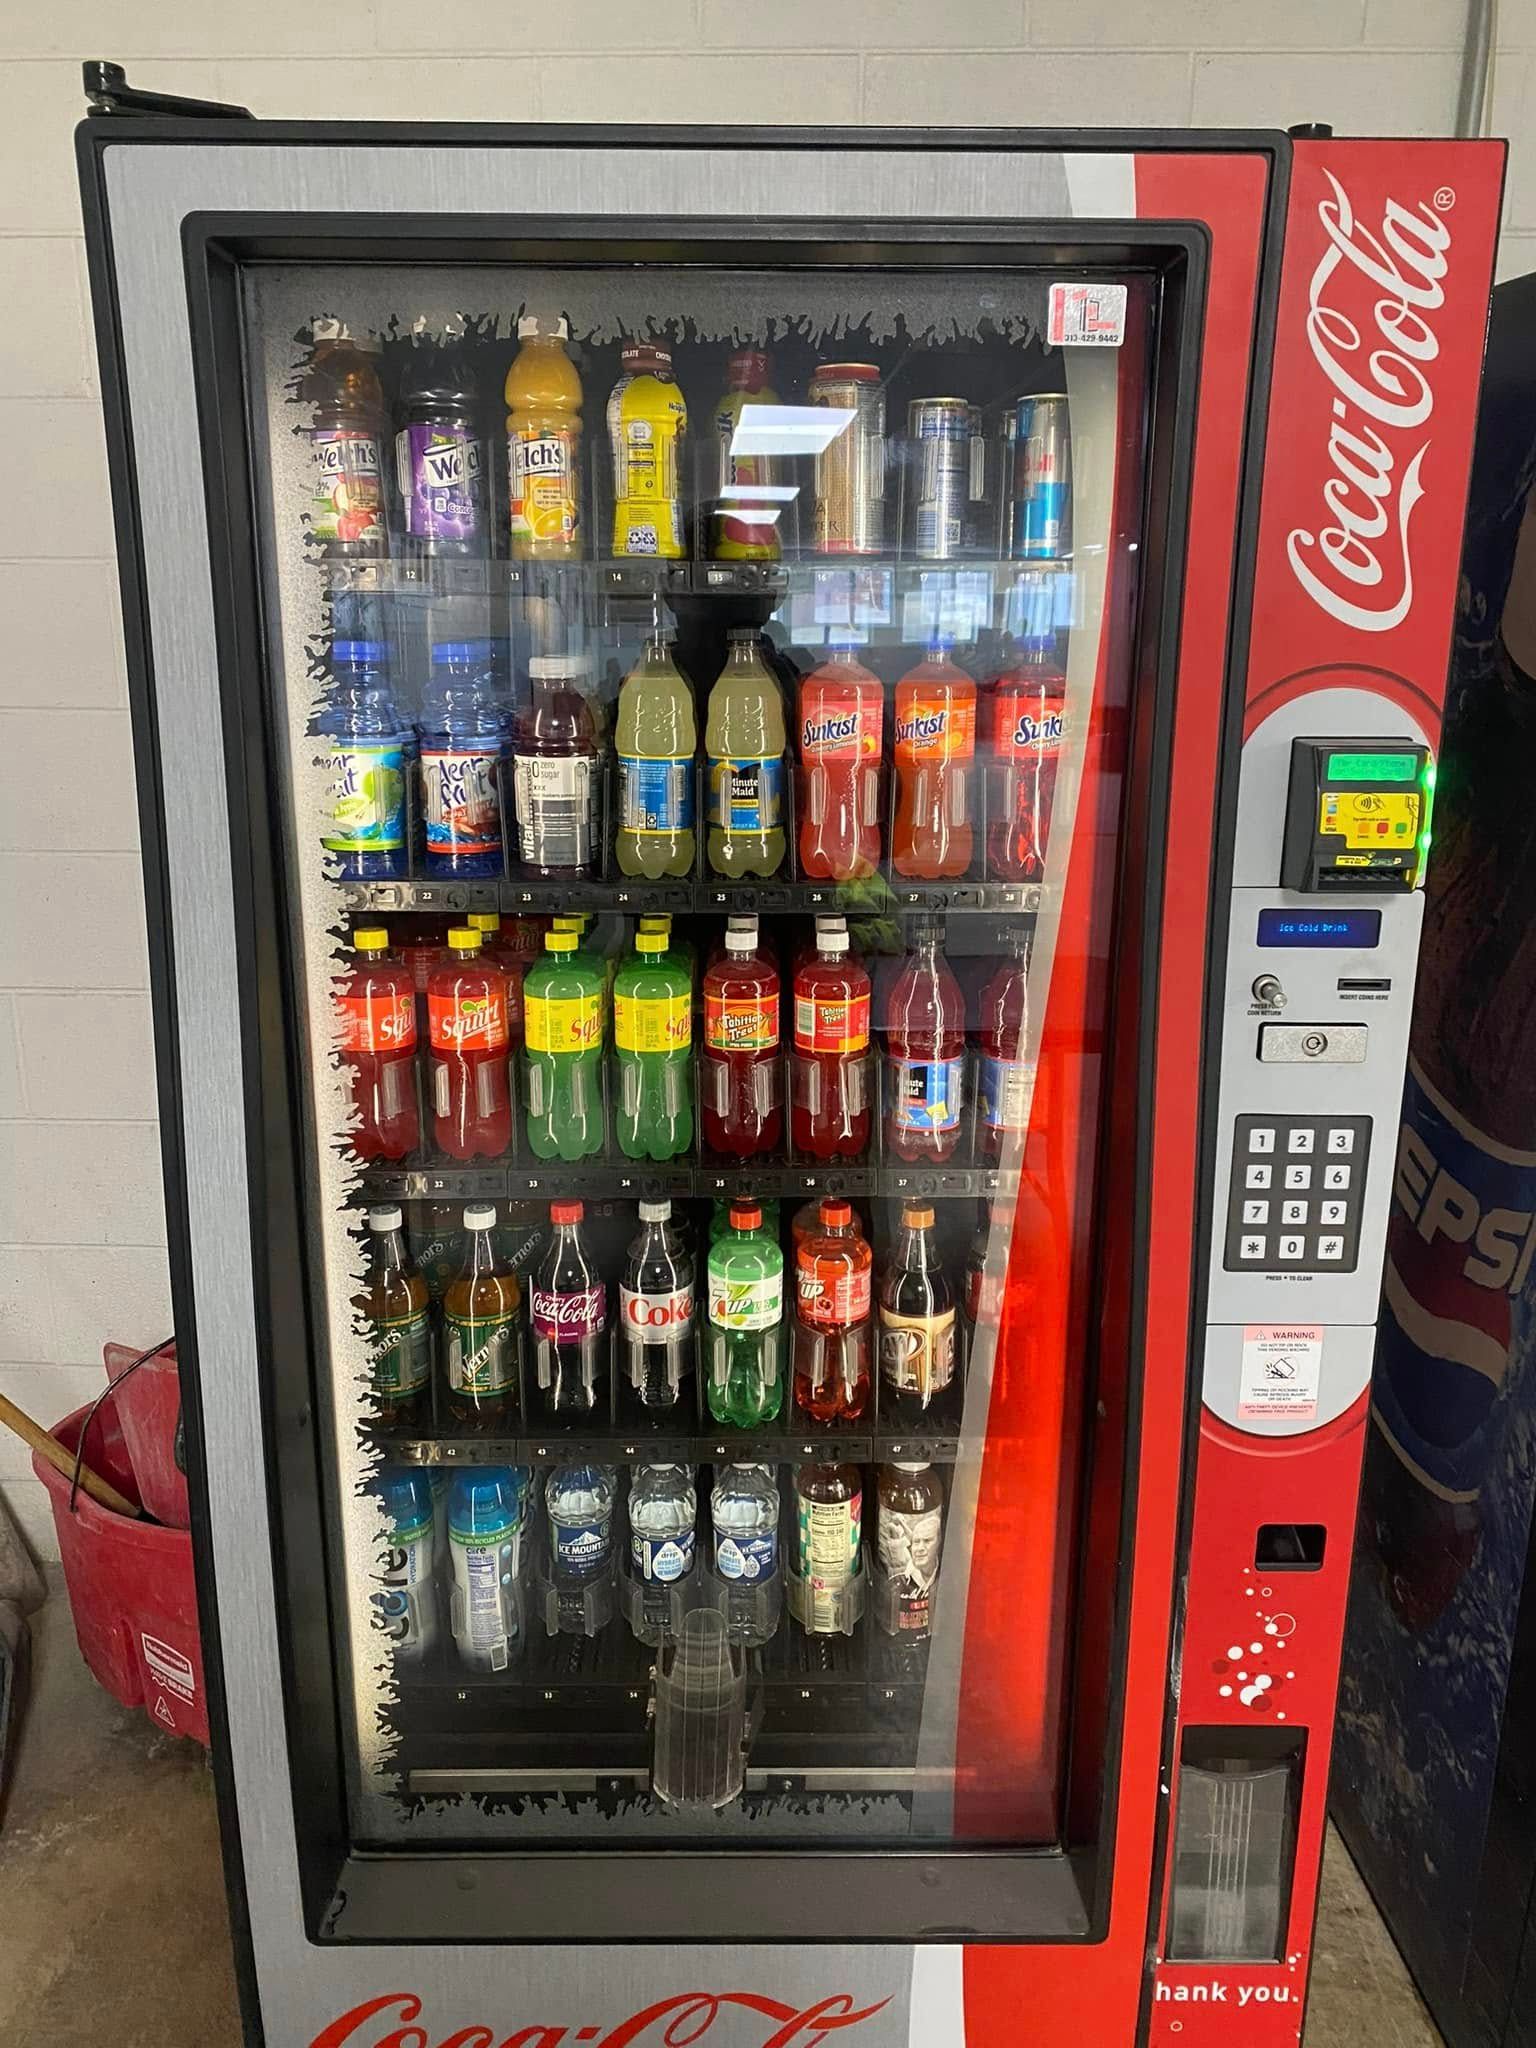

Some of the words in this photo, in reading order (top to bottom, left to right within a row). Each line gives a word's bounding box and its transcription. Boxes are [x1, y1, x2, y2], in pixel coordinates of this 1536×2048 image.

[1288, 168, 1451, 632] Coca-Cola
[406, 570, 416, 579] 12
[510, 572, 520, 580] 13
[612, 573, 622, 581] 14
[804, 713, 858, 747] Sunkist
[895, 711, 948, 744] Sunkist
[422, 892, 432, 900] 22
[522, 893, 532, 901] 23
[616, 893, 627, 901] 24
[909, 893, 919, 901] 27
[1280, 923, 1294, 932] Ice
[1298, 923, 1319, 932] Cold
[441, 1000, 499, 1043] Squirt
[722, 1013, 763, 1029] Tahitian
[729, 1023, 758, 1041] Treat
[1258, 1135, 1266, 1147] 1
[1297, 1135, 1307, 1148] 2
[1336, 1135, 1346, 1148] 3
[622, 1179, 631, 1187] 34
[898, 1178, 908, 1187] 37
[1254, 1171, 1265, 1183] 4
[1293, 1171, 1304, 1183] 5
[1333, 1171, 1343, 1184] 6
[434, 1180, 444, 1188] 32
[529, 1180, 538, 1188] 33
[1251, 1206, 1263, 1218] 7
[1290, 1206, 1301, 1218] 8
[1329, 1206, 1340, 1219] 9
[1287, 1241, 1297, 1254] 0
[1324, 1241, 1337, 1254] #
[533, 1290, 601, 1323] Coca-Cola
[628, 1295, 693, 1326] Coke
[1272, 1331, 1316, 1340] WARNING
[447, 1448, 457, 1456] 42
[626, 1447, 636, 1455] 44
[892, 1445, 902, 1454] 47
[1238, 1985, 1300, 2007] you.
